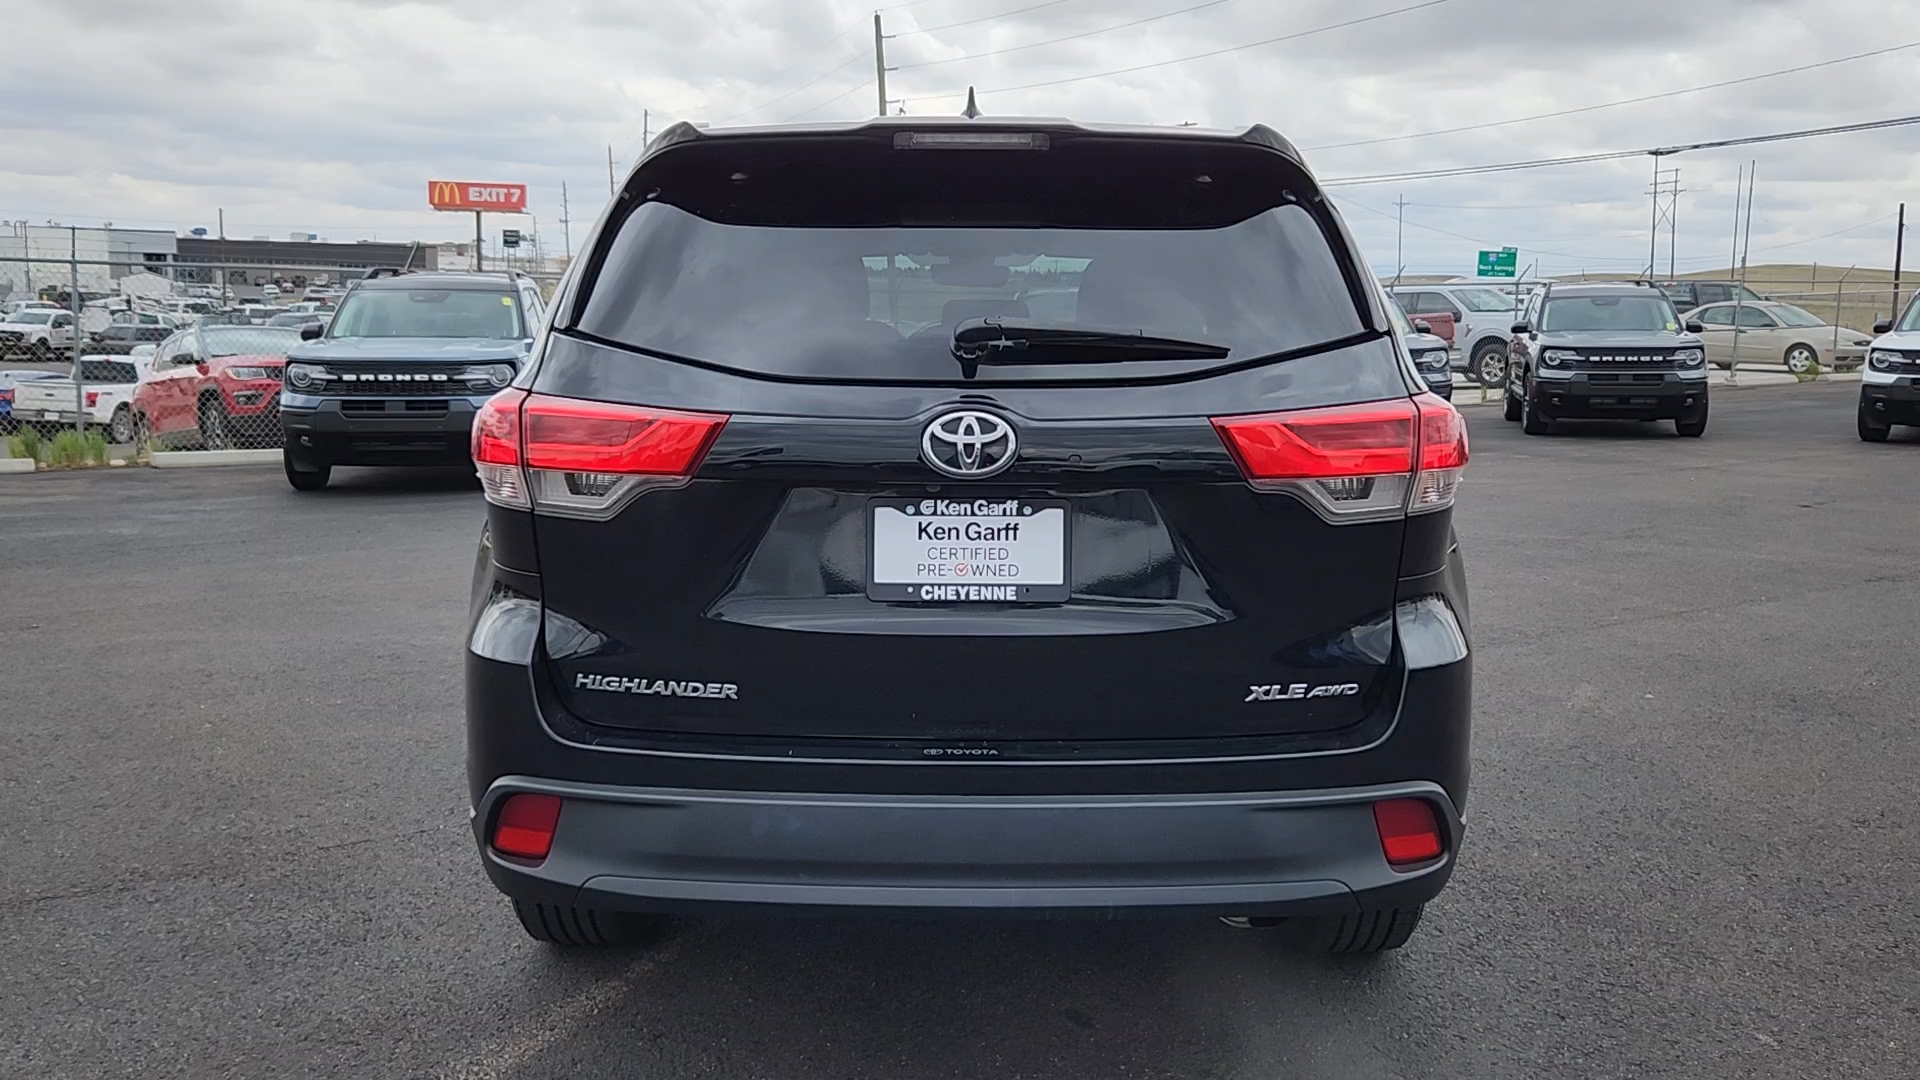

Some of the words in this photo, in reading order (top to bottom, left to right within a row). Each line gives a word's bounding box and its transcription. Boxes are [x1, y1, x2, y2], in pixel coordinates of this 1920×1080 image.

[468, 186, 508, 202] EXIT
[509, 188, 521, 203] 7
[936, 500, 971, 516] Ken
[973, 500, 1019, 516] Garff
[918, 521, 960, 541] Ken
[965, 521, 1019, 542] Garff
[927, 547, 1009, 561] CERTIFIED
[920, 585, 1017, 601] CHEYENNE
[575, 673, 738, 699] HIGHLANDER
[1244, 683, 1308, 702] XLE
[1306, 683, 1359, 698] AWD
